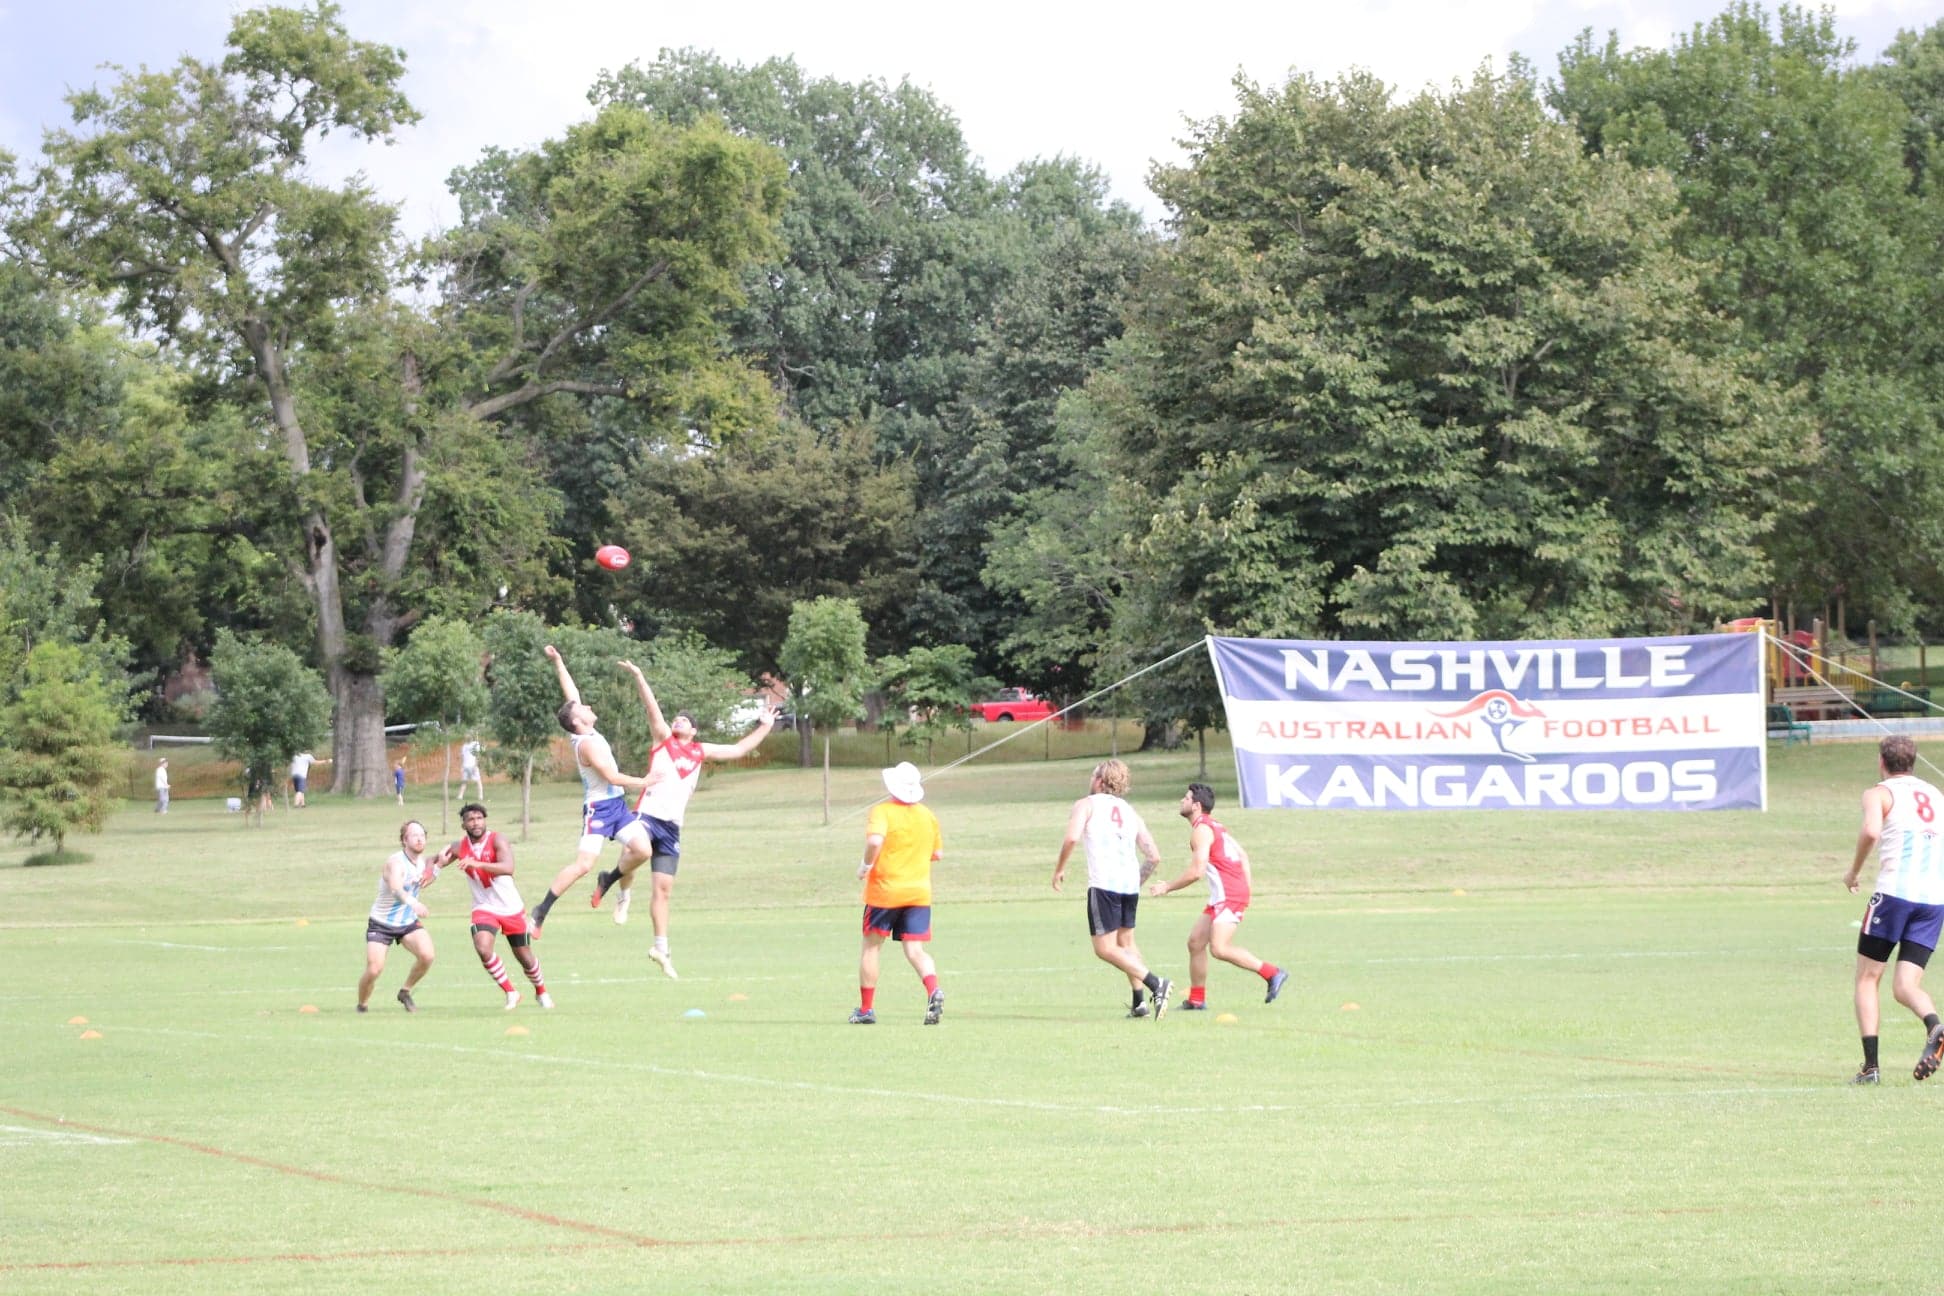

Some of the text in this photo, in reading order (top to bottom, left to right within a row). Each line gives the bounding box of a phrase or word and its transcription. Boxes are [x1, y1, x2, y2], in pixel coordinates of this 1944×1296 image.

[1280, 645, 1695, 690] NASHVILLE
[1256, 716, 1720, 739] AUSTRALIAN FOOTBALL
[1265, 759, 1717, 806] KANGAROOS
[1111, 806, 1123, 828] 4
[1914, 791, 1934, 822] 8
